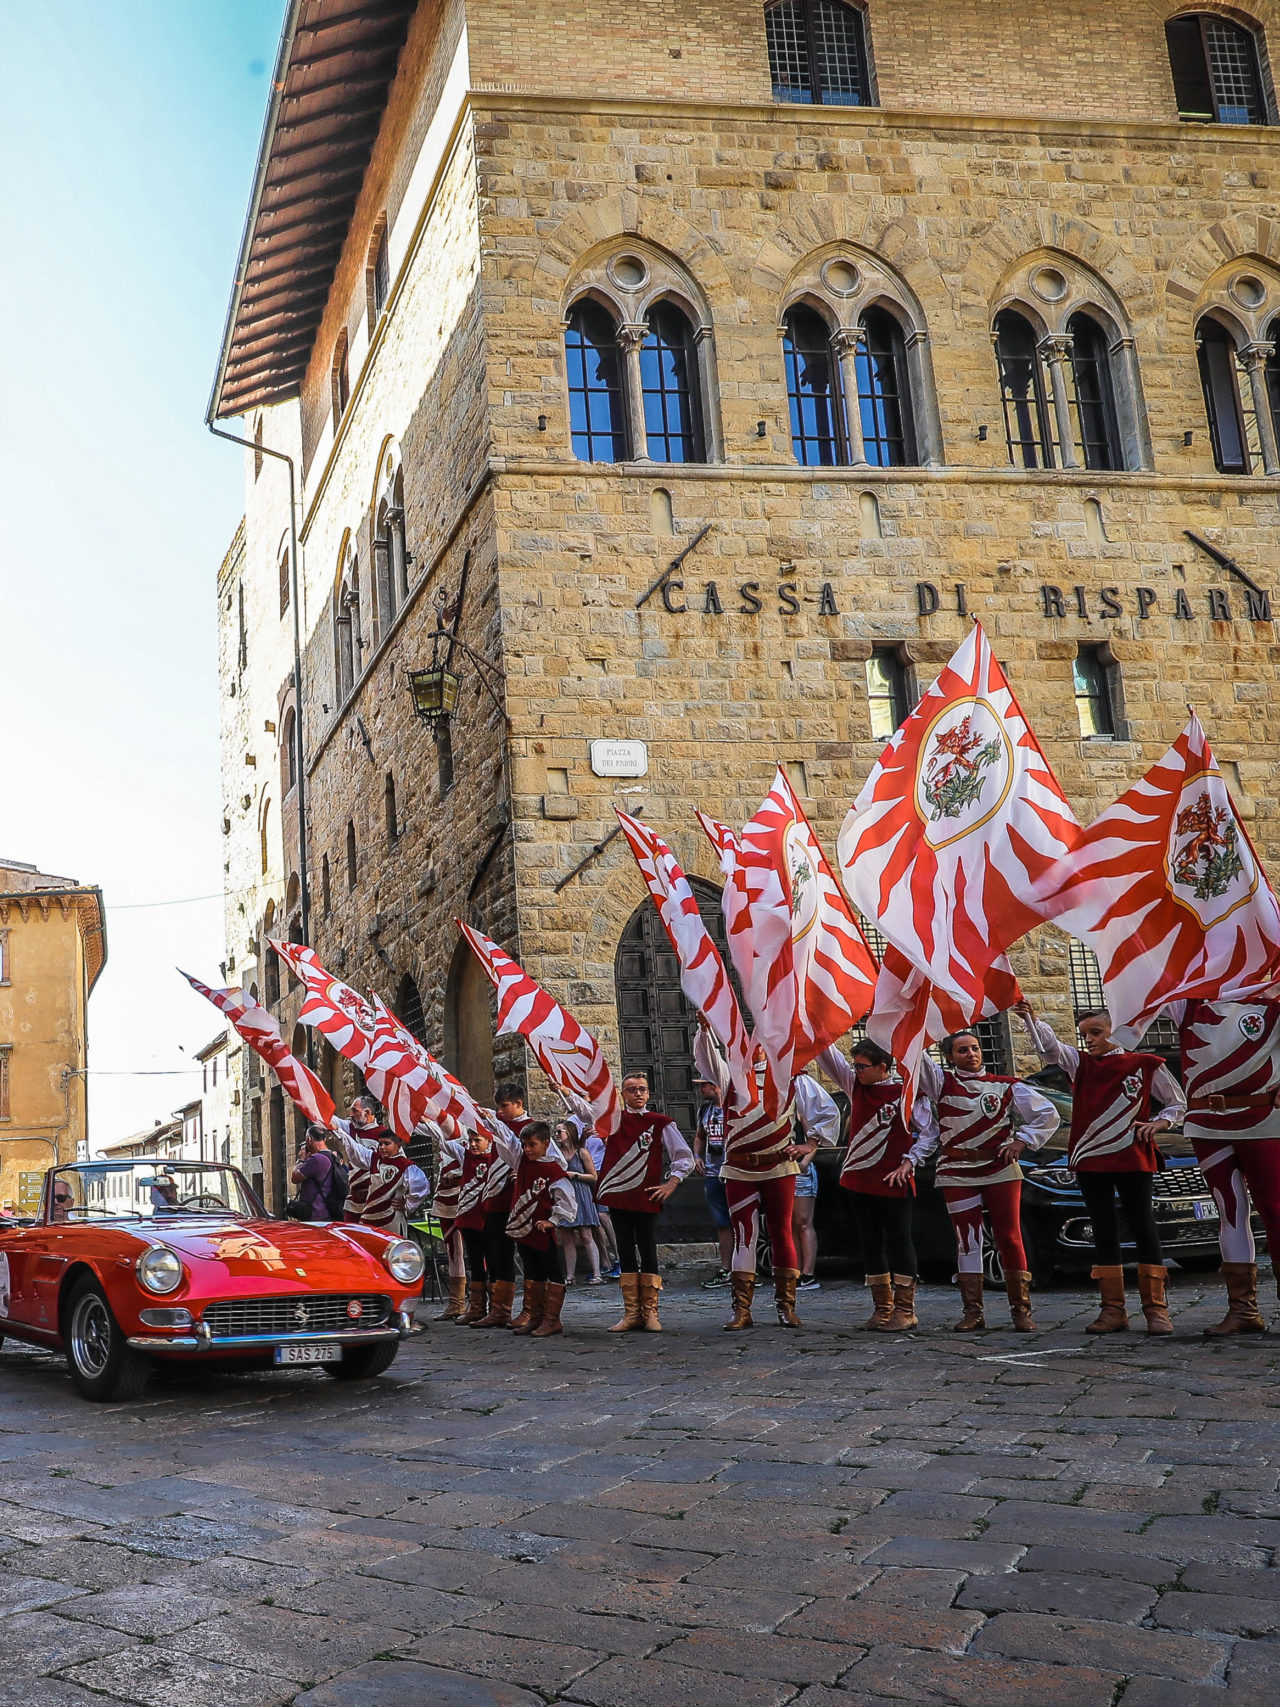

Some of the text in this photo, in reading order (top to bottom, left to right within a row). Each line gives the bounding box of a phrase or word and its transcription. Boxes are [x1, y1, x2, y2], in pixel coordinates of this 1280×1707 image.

[662, 580, 1274, 621] CASSA DI RISPARM
[606, 748, 632, 756] PIAZZA
[288, 1347, 334, 1361] SAS 275
